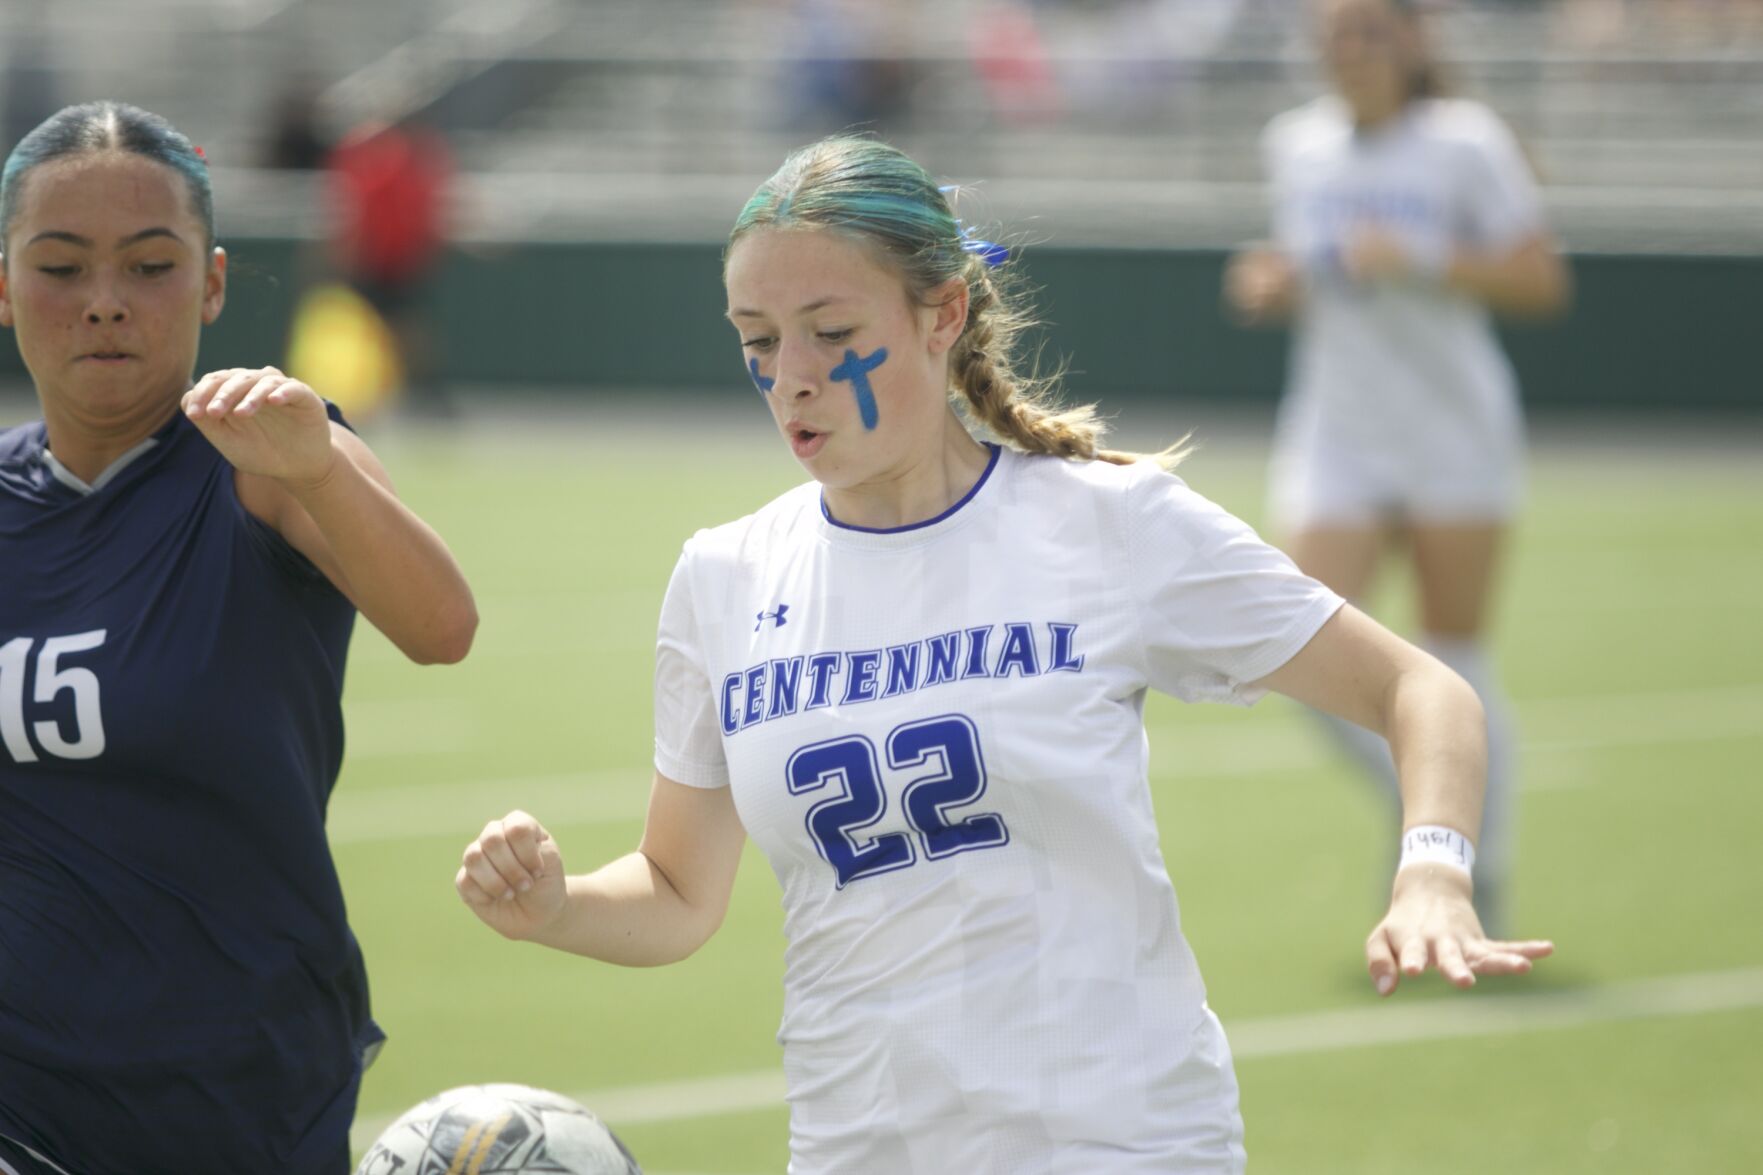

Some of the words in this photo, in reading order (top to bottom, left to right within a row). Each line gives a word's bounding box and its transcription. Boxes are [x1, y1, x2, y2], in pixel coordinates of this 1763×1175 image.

[0, 628, 107, 763] 15
[721, 622, 1085, 736] CENTENNIAL
[785, 713, 1010, 891] 22
